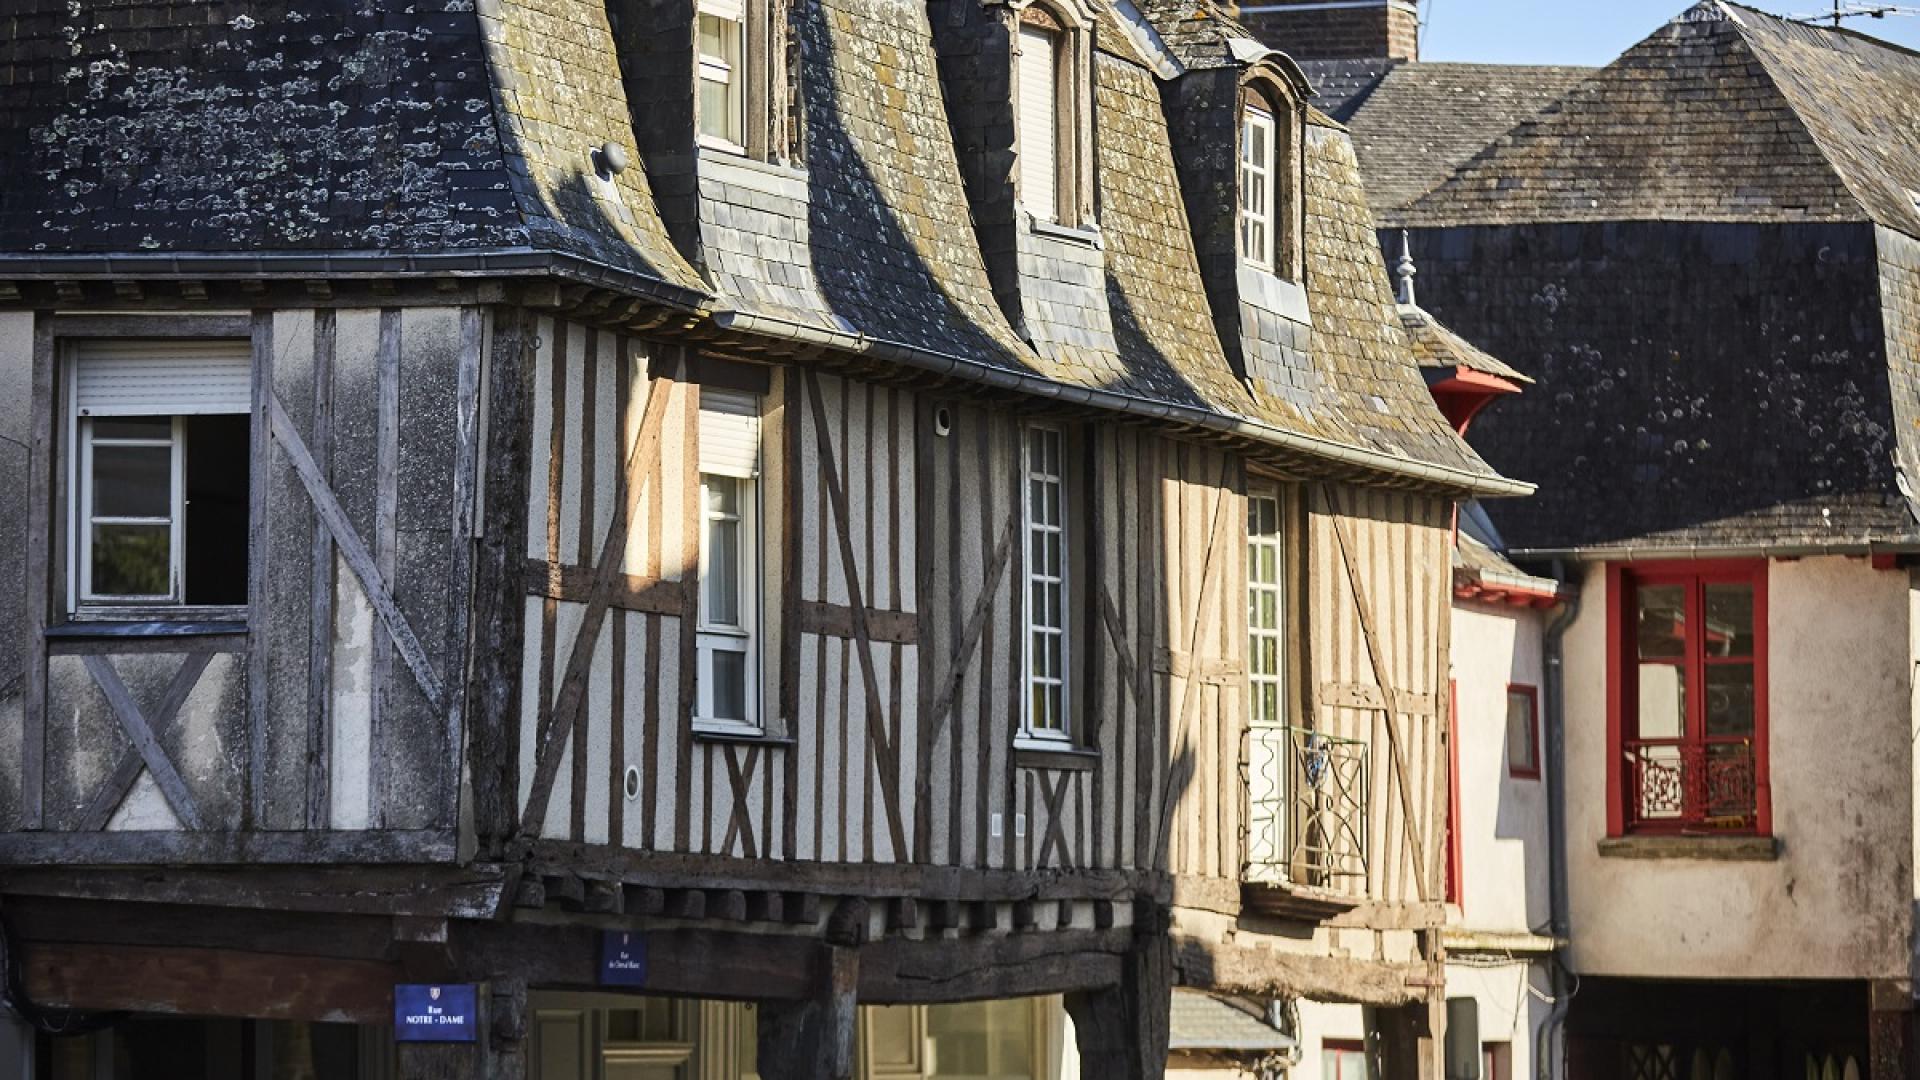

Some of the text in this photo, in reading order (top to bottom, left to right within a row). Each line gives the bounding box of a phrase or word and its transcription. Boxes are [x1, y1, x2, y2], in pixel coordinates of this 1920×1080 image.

[428, 1005, 442, 1014] Rue
[406, 1015, 433, 1025] NOTRE
[439, 1015, 464, 1025] DAME
